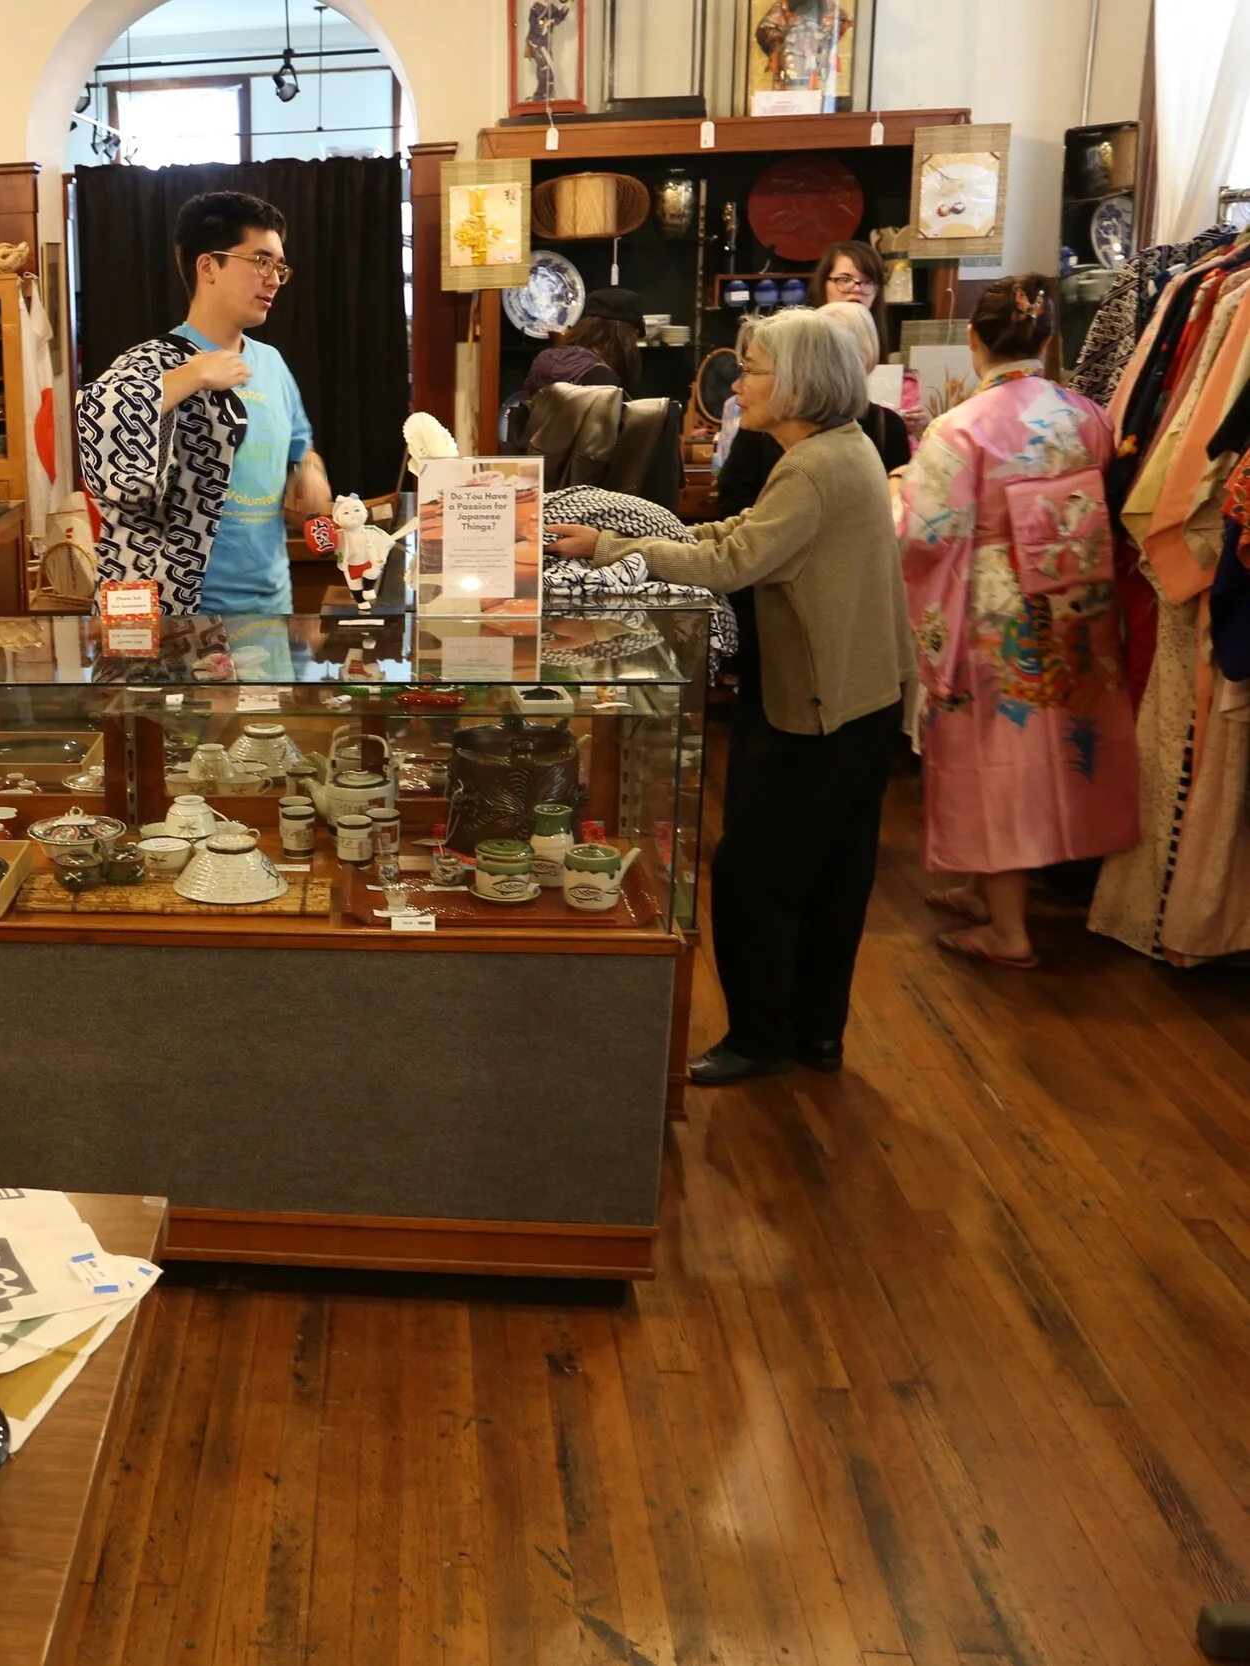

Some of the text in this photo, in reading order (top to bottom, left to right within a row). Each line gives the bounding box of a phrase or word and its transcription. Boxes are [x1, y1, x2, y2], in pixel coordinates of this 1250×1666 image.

[465, 492, 483, 500] You
[485, 492, 508, 500] Have
[457, 503, 492, 511] Passion
[494, 503, 508, 511] for
[457, 513, 501, 521] Japanese
[462, 523, 496, 532] Things?
